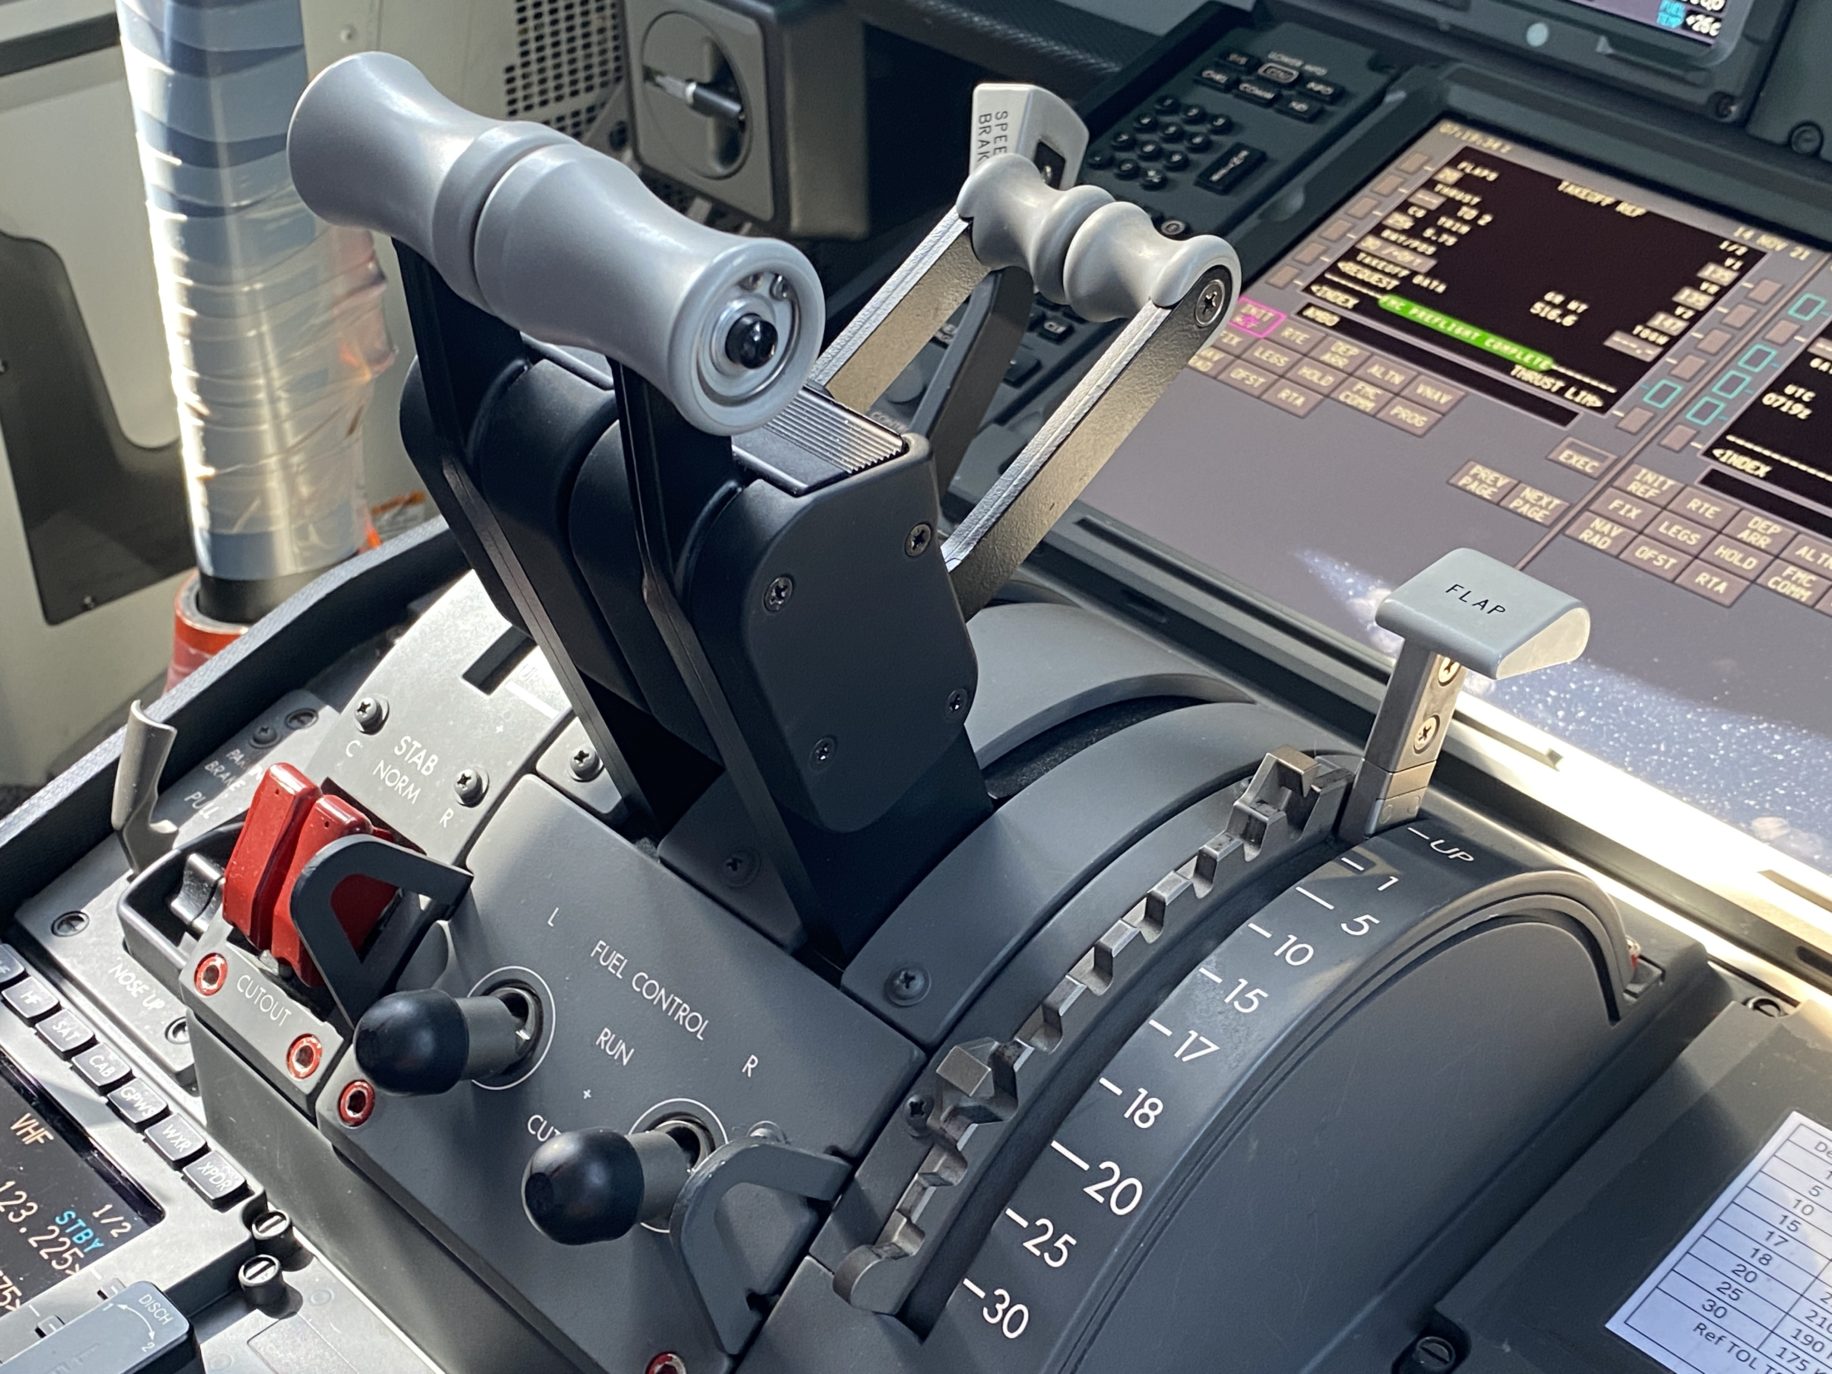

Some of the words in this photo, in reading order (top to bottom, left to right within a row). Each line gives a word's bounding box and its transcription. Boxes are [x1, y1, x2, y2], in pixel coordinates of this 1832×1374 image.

[977, 112, 992, 162] BRAK
[994, 110, 1009, 155] SPEE
[1280, 327, 1310, 345] RTE
[1408, 306, 1480, 341] PREFLIGHT
[1484, 338, 1552, 369] COMPLETE
[1297, 365, 1334, 387] HOLD
[1367, 363, 1405, 386] ALTN
[1510, 364, 1565, 392] THRUST
[1809, 357, 1832, 376] GA
[1277, 388, 1305, 407] RTA
[1389, 405, 1428, 428] PROG
[1558, 449, 1600, 473] EXEC
[1457, 475, 1500, 500] PAGE
[1469, 464, 1511, 488] PREV
[1634, 467, 1676, 491] INIT
[1519, 486, 1561, 511] NEXT
[1627, 481, 1661, 499] REF
[1508, 499, 1550, 523] PAGE
[1607, 499, 1642, 520] FIX
[1687, 498, 1722, 519] RTE
[1589, 518, 1623, 538] NAV
[1658, 521, 1703, 546] LEGS
[1747, 515, 1783, 535] DEP
[1578, 528, 1612, 550] RAD
[1737, 530, 1772, 550] ARR
[1635, 545, 1678, 571] OFST
[1714, 545, 1758, 571] HOLD
[1695, 572, 1729, 595] RTA
[1767, 576, 1812, 602] COMM
[1782, 565, 1816, 588] FMC
[1445, 584, 1506, 614] FLAP
[345, 739, 363, 758] C
[394, 736, 439, 776] STAB
[373, 759, 422, 805] NORM
[184, 791, 220, 819] PULL
[440, 807, 456, 828] R
[1430, 839, 1474, 861] UP
[1376, 876, 1399, 892] 1
[547, 907, 559, 927] L
[1340, 914, 1380, 937] 5
[1272, 934, 1315, 967] 10
[108, 963, 145, 997] NOSE
[143, 990, 165, 1010] UP
[591, 939, 632, 979] FUEL
[631, 972, 710, 1041] CONTROL
[1223, 979, 1269, 1014] 15
[237, 974, 292, 1027] CUTOUT
[52, 1020, 80, 1042] SAT
[595, 1027, 635, 1066] RUN
[1173, 1030, 1221, 1063] 17
[89, 1053, 115, 1078] CAB
[742, 1054, 759, 1078] R
[120, 1085, 156, 1118] GPWS
[1124, 1087, 1164, 1129] 18
[10, 1113, 54, 1145] VHF
[163, 1123, 192, 1152] WXR
[527, 1114, 562, 1143] CUT
[197, 1161, 232, 1192] XPDR
[1083, 1160, 1143, 1216] 20
[1807, 1184, 1823, 1197] 5
[1792, 1198, 1815, 1217] 10
[55, 1210, 104, 1253] STBY
[92, 1203, 132, 1238] 1/2
[1779, 1213, 1802, 1233] 15
[1023, 1217, 1078, 1268] 25
[1765, 1230, 1789, 1247] 17
[1750, 1247, 1773, 1266] 18
[1731, 1263, 1758, 1283] 20
[1716, 1281, 1744, 1302] 25
[1820, 1291, 1832, 1307] 2
[139, 1293, 174, 1326] DISCH
[982, 1288, 1029, 1339] 30
[1701, 1298, 1728, 1319] 30
[1790, 1328, 1825, 1353] 190
[141, 1343, 156, 1353] 2
[1692, 1322, 1727, 1346] Ref
[1727, 1340, 1758, 1370] TOL
[1775, 1346, 1811, 1372] 175
